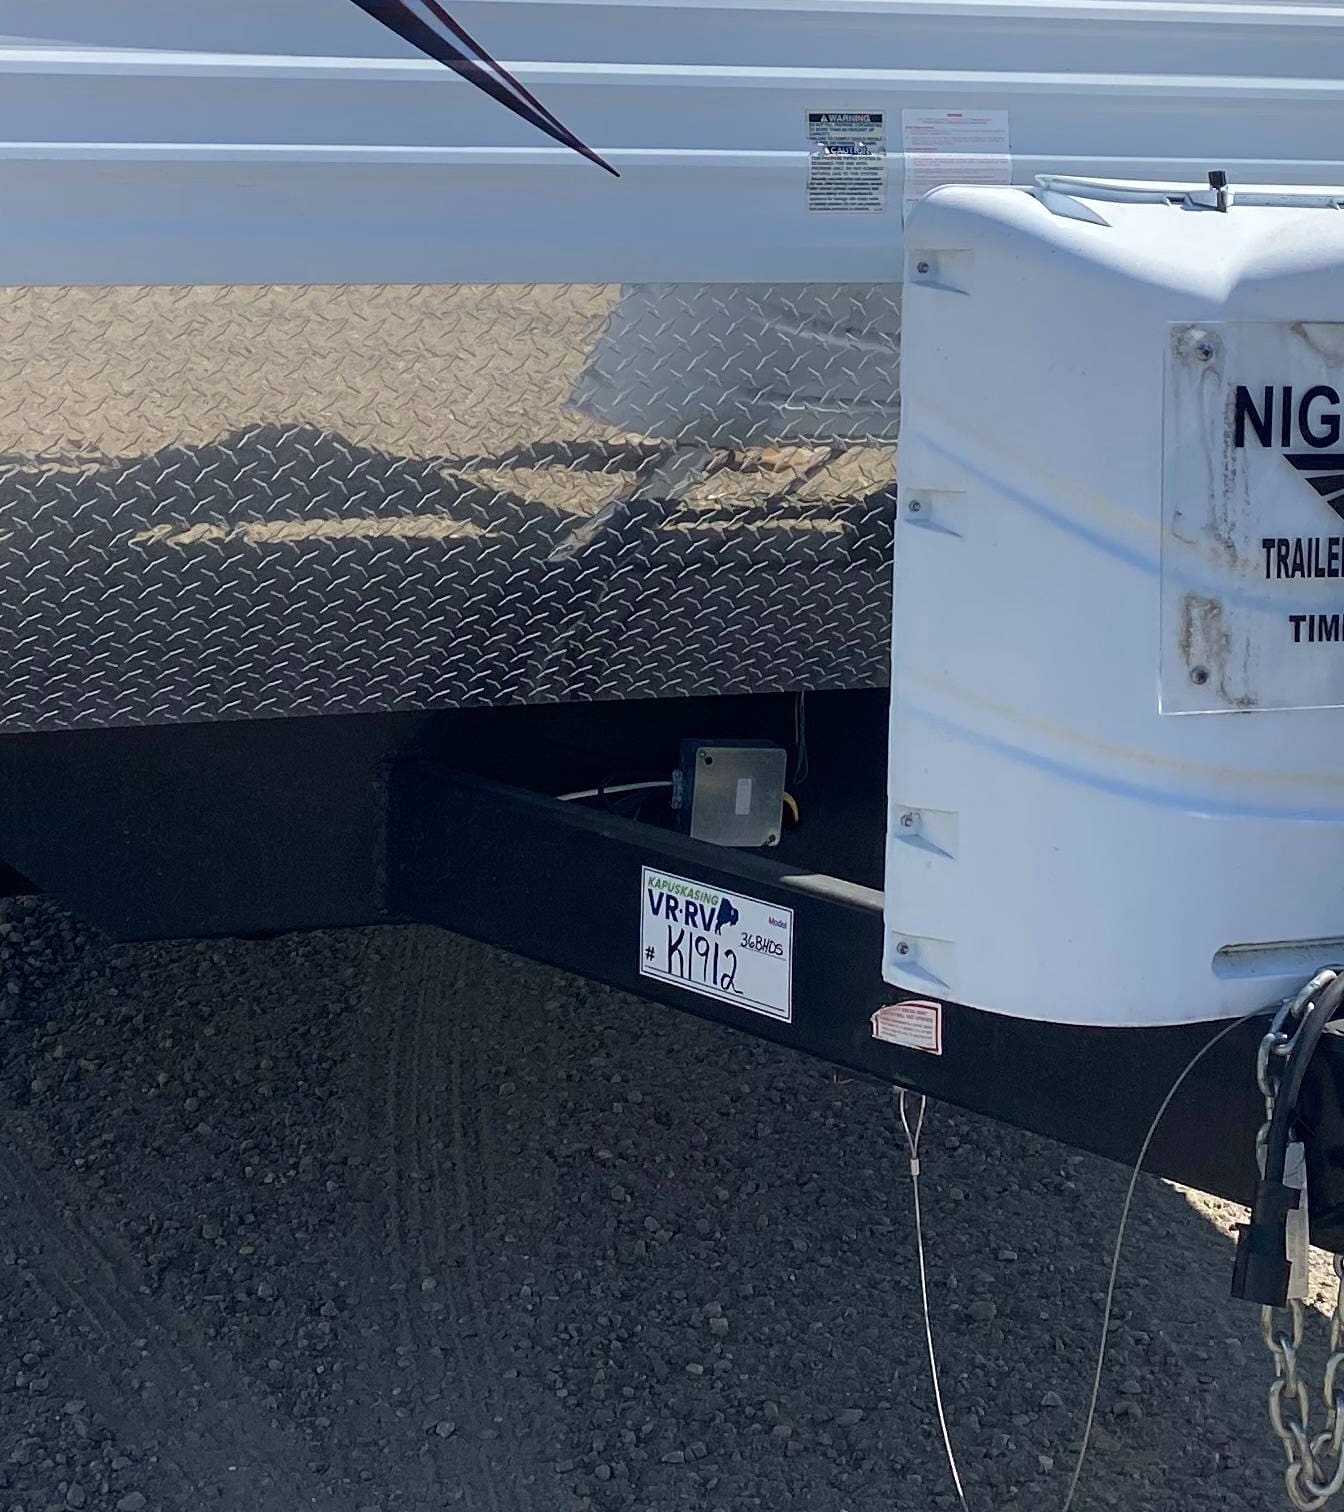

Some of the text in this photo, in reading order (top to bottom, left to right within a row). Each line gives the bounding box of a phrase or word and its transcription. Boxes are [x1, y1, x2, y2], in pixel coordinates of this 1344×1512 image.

[828, 114, 871, 122] WARNING
[648, 875, 719, 906] KAPUSKASING
[768, 915, 787, 930] Model
[667, 924, 744, 995] K1912
